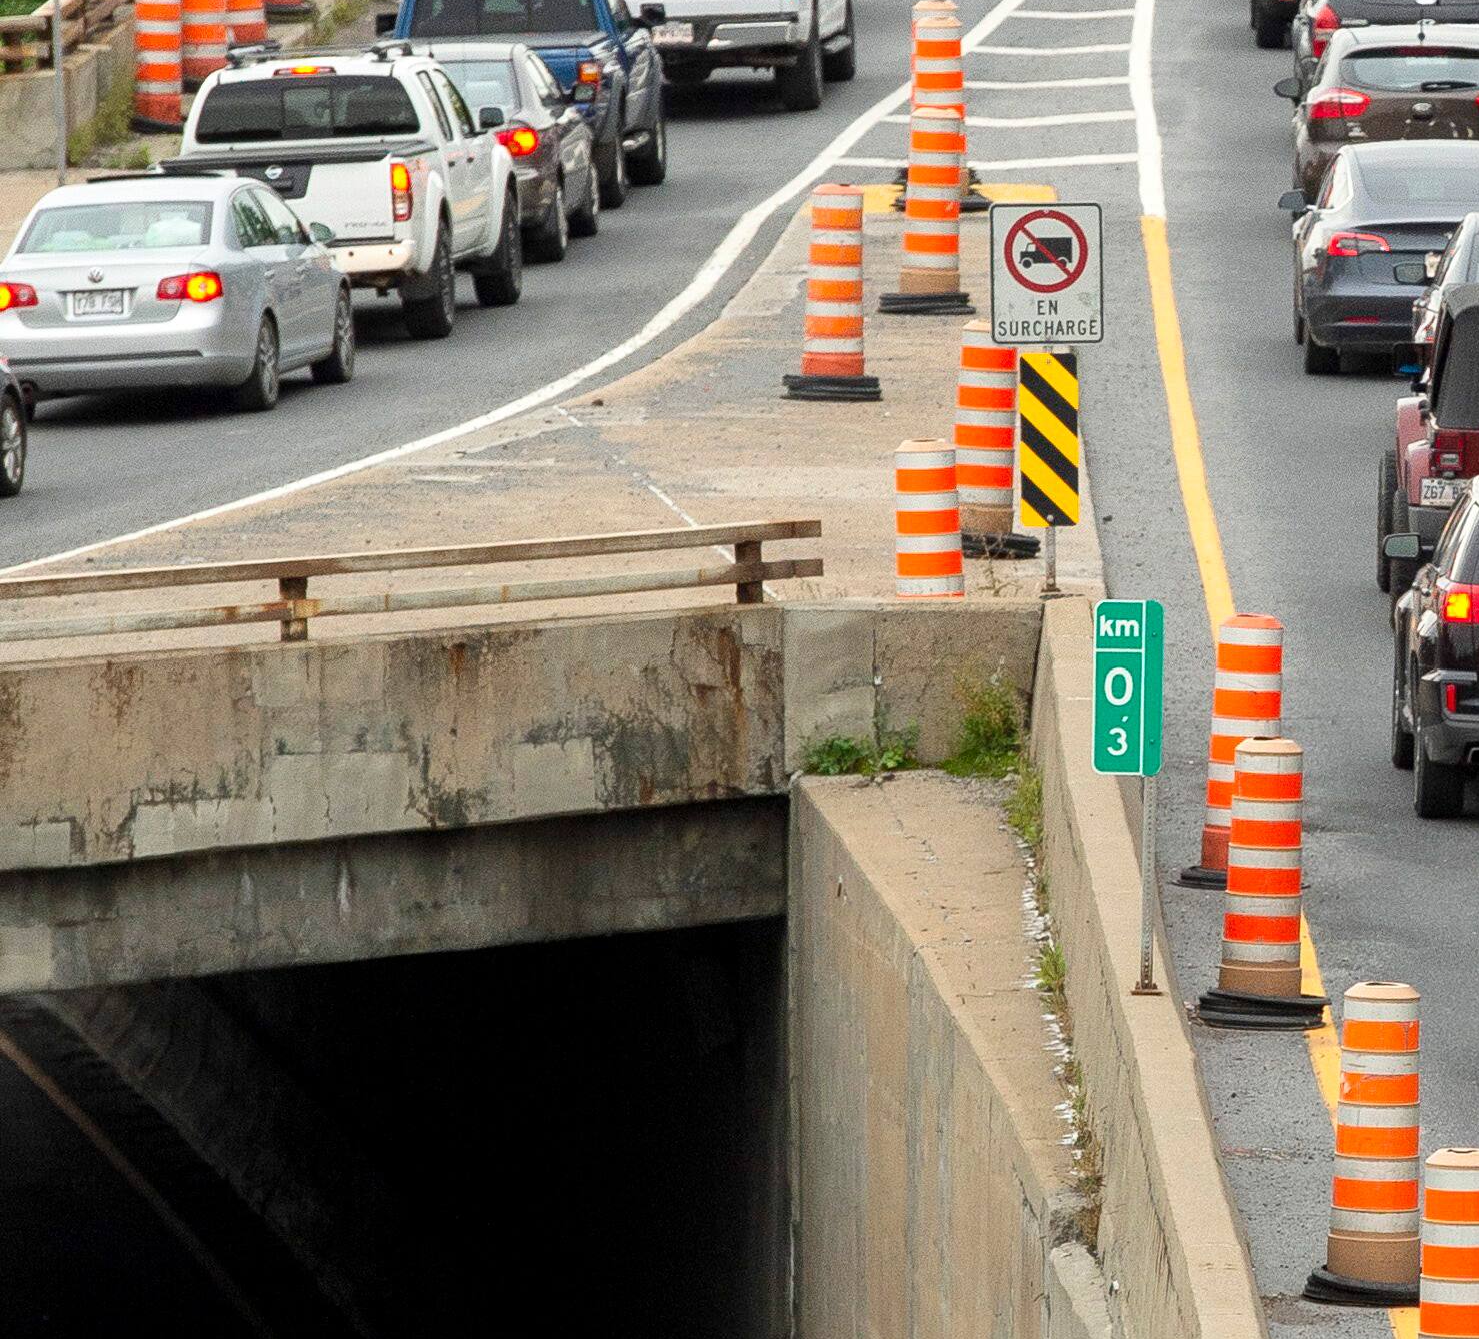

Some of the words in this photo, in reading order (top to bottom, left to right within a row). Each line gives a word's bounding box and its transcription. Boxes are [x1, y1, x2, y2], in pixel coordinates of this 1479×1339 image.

[1037, 300, 1058, 316] EN
[998, 320, 1098, 337] SURCHARGE
[1423, 484, 1446, 500] Z67
[1100, 615, 1140, 637] km
